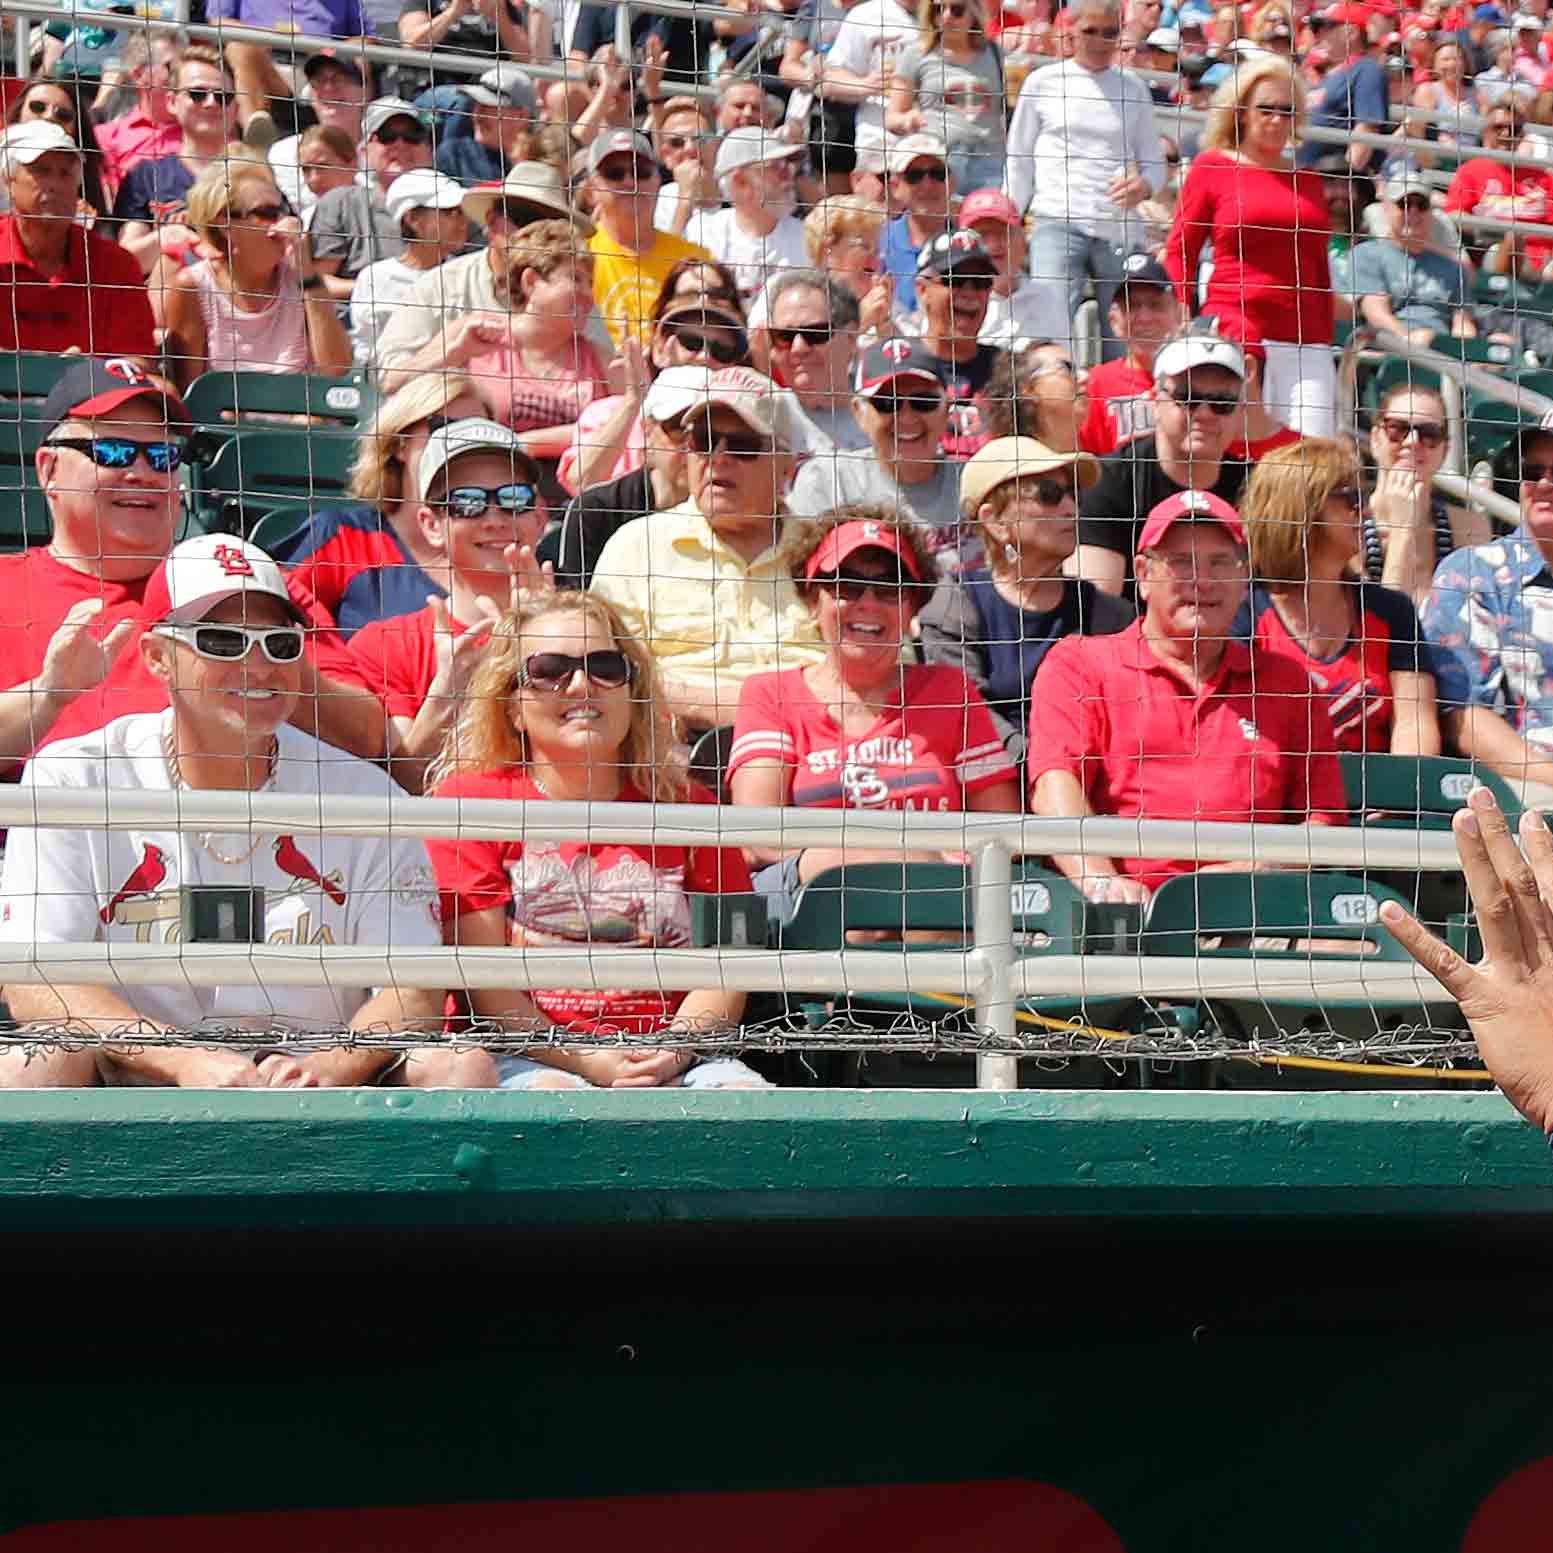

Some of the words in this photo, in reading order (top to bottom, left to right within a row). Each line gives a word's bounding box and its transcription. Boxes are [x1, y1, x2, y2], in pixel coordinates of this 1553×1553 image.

[845, 736, 913, 767] LOUIS
[1011, 886, 1039, 912] 17
[1340, 898, 1368, 920] 18
